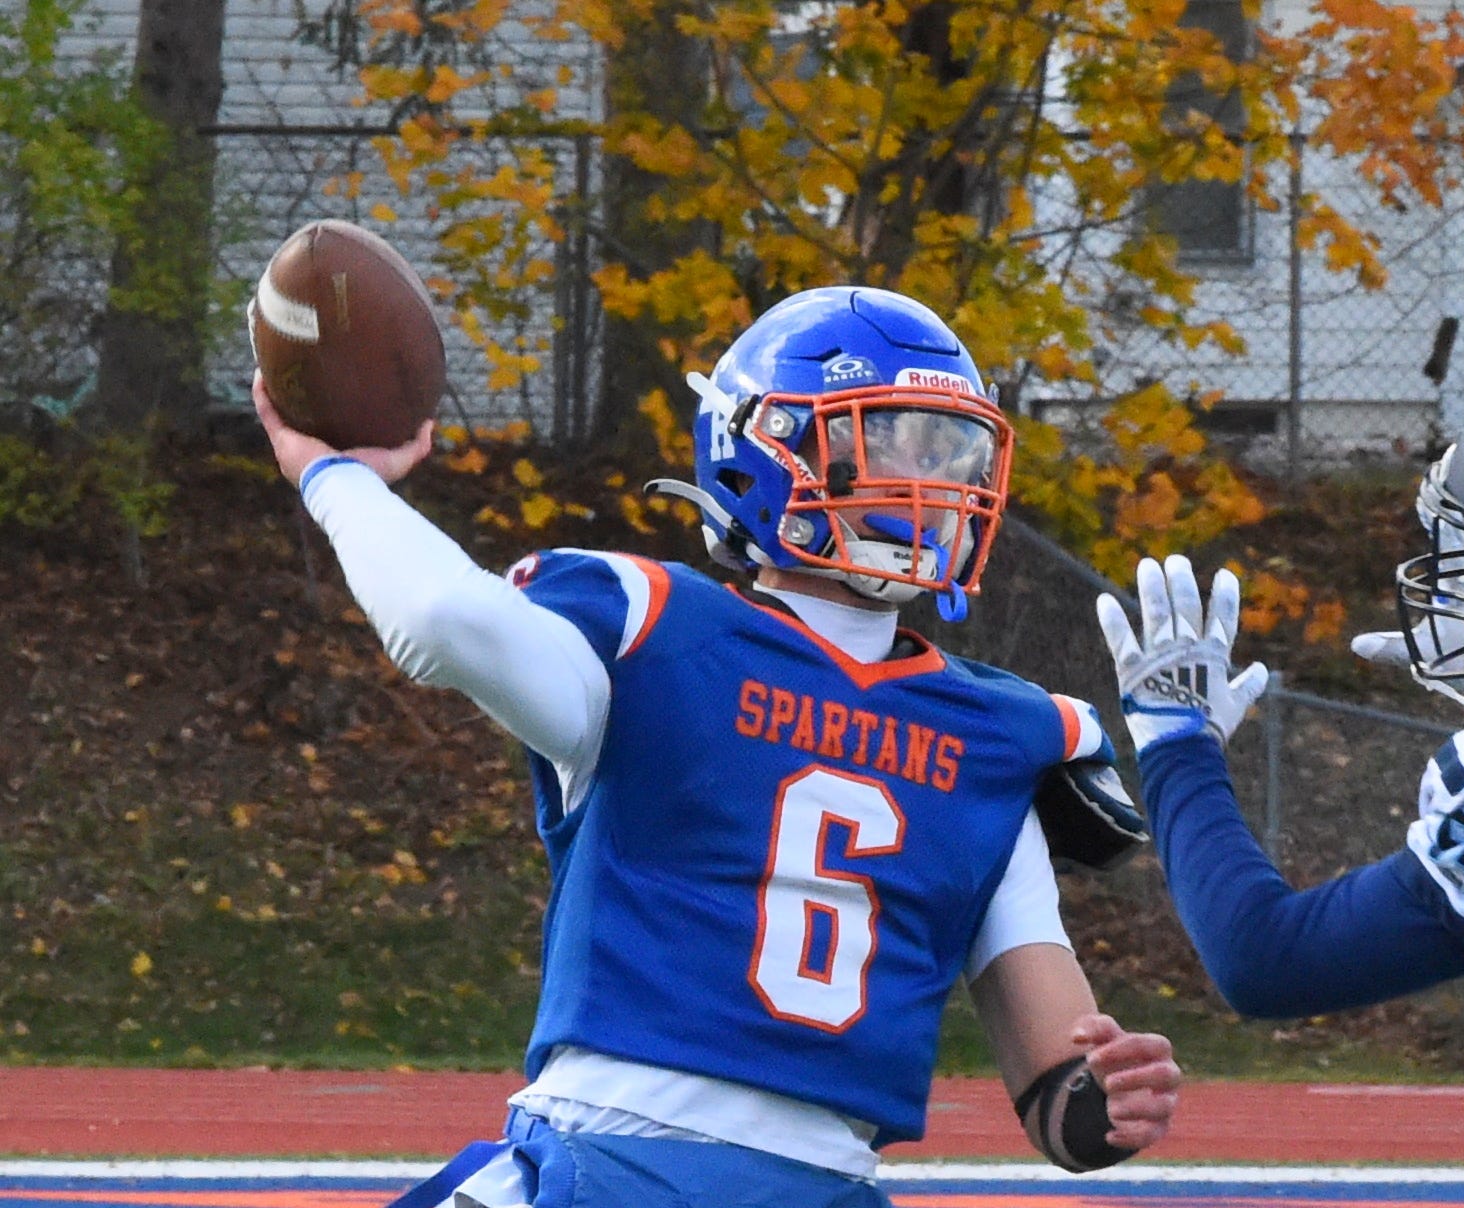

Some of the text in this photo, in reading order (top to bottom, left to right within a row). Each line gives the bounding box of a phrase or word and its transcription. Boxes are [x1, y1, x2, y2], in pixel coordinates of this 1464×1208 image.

[907, 370, 971, 393] Riddell
[735, 679, 965, 794] SPARTANS
[746, 761, 908, 1036] 6
